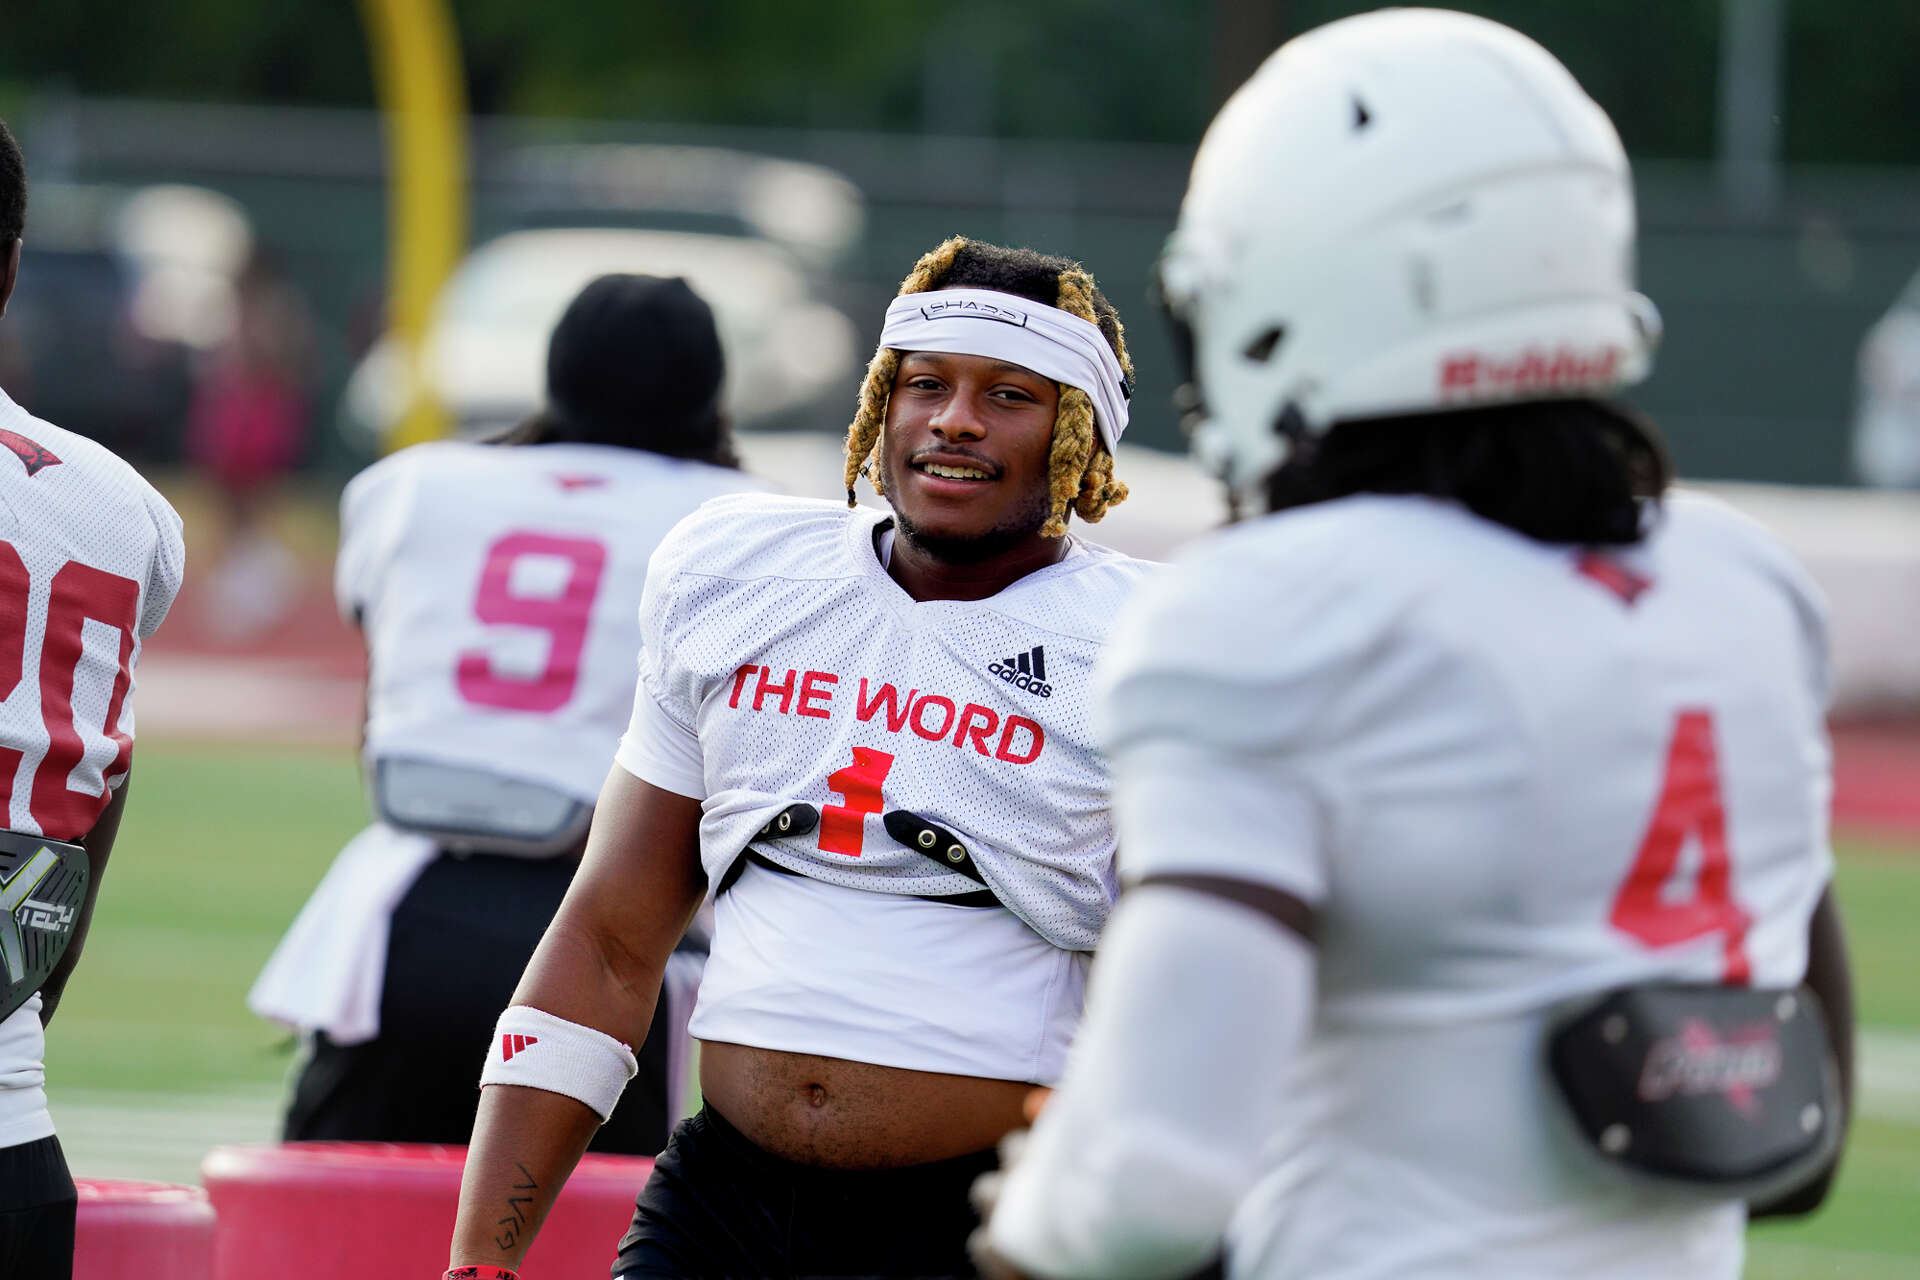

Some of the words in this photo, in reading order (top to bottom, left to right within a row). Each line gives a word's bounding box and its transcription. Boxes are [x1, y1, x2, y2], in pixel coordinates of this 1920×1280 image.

[456, 527, 607, 714] 9
[728, 664, 839, 721] THE
[856, 677, 1045, 765] WORD
[988, 663, 1053, 698] adidas
[817, 746, 895, 858] 1
[1609, 706, 1754, 986] 4
